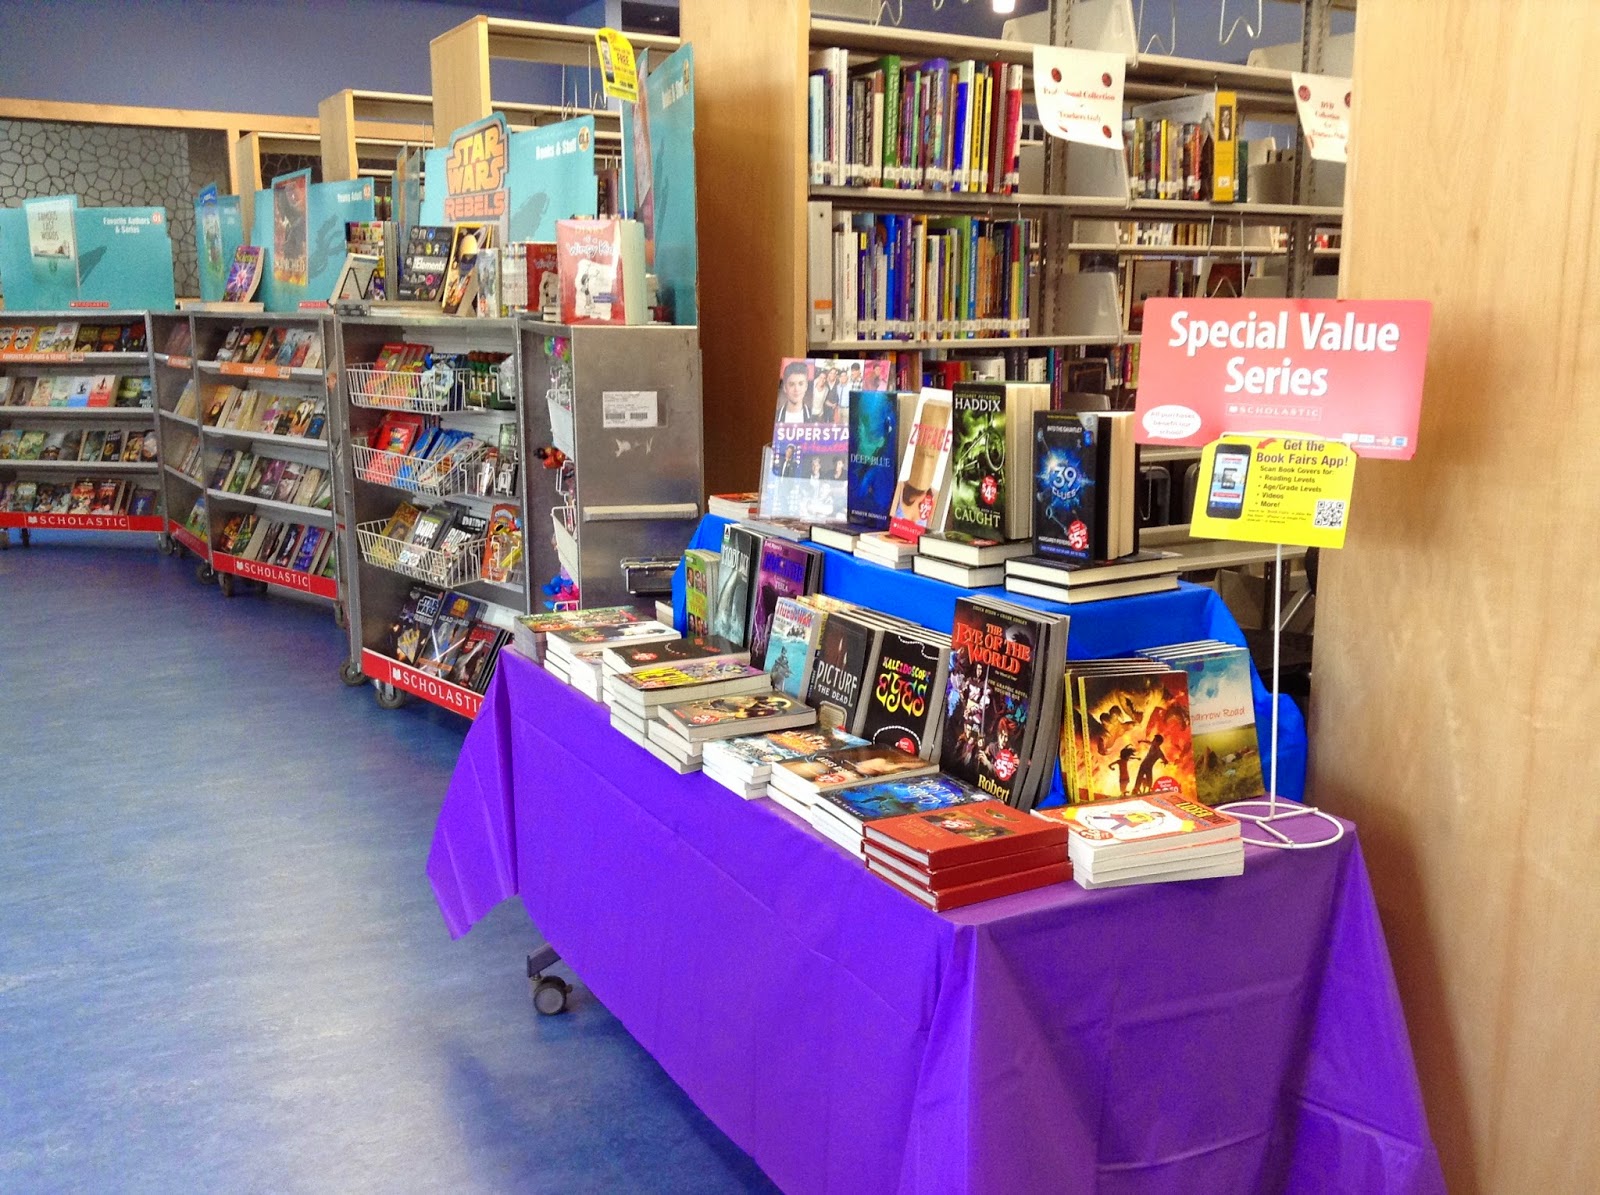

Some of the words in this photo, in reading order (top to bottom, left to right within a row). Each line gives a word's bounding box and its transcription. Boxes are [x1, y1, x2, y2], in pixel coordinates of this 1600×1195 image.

[447, 126, 504, 169] STAR
[447, 156, 504, 195] WARS
[445, 192, 505, 220] REBELS
[128, 217, 151, 225] Authors
[1168, 311, 1288, 357] Special
[1299, 312, 1400, 352] Value
[1224, 356, 1328, 397] Series
[954, 398, 1001, 412] HADDIX
[1239, 405, 1319, 417] SCHOLASTIC
[777, 427, 849, 441] SUPERSTA
[909, 423, 953, 452] ZITFACE
[1283, 440, 1302, 451] Get
[1306, 440, 1325, 452] the
[850, 453, 869, 465] DEEP
[870, 457, 891, 468] BLUE
[1256, 452, 1284, 463] Book
[1288, 453, 1317, 465] Fairs
[1321, 455, 1349, 468] App!
[1278, 465, 1295, 473] Book
[1297, 466, 1321, 475] Covers
[1052, 465, 1077, 488] 39
[1264, 474, 1292, 483] Reading
[1051, 486, 1078, 500] CLUES
[1263, 483, 1298, 491] Age/Grade
[1300, 485, 1322, 493] Levels
[40, 515, 127, 527] SCHOLASTIC
[954, 507, 1001, 528] CAUGHT
[721, 545, 740, 570] MOBY
[244, 562, 309, 587] SCHOLASTIC
[416, 606, 437, 617] WARS
[419, 597, 440, 609] STAR
[986, 623, 1003, 636] THE
[956, 622, 984, 645] EYE
[985, 633, 1003, 651] OF
[1004, 639, 1031, 662] THE
[883, 656, 931, 682] KALEIDOSCOPE
[967, 643, 1021, 675] WORLD
[814, 660, 858, 707] PICTURE
[817, 684, 830, 695] THE
[831, 688, 848, 704] DEAD
[876, 672, 927, 717] EYES
[1189, 709, 1220, 722] parrow
[1223, 707, 1245, 719] Road
[978, 774, 1010, 802] Robert
